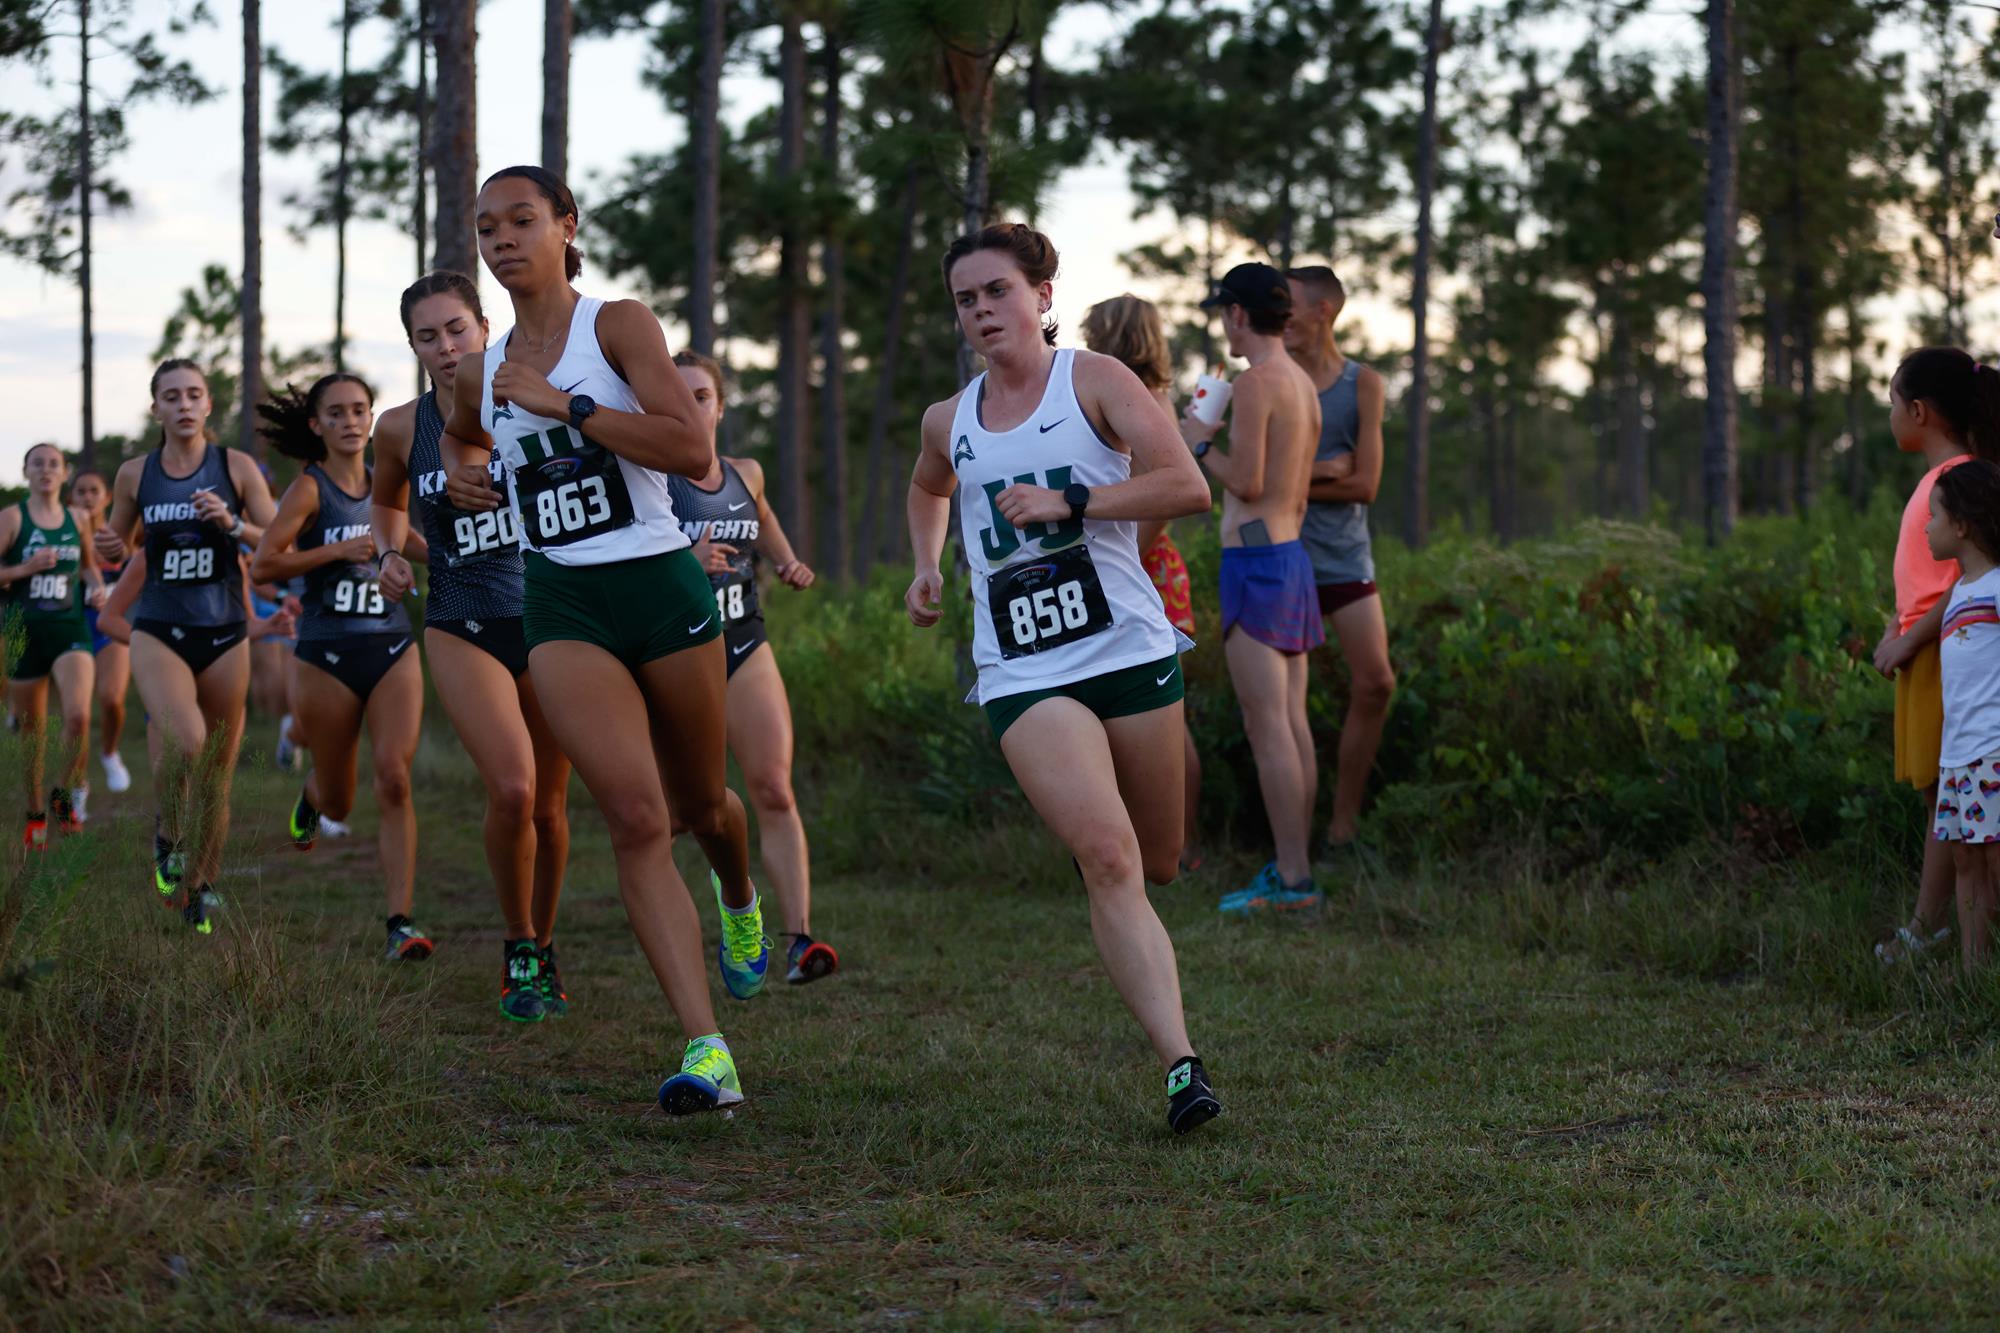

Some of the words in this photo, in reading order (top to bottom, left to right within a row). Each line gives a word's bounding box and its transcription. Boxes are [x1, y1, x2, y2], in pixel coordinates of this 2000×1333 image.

[144, 502, 228, 524] KNIG
[536, 475, 612, 540] 863
[454, 506, 520, 557] 920
[679, 520, 759, 540] NIGHTS
[163, 548, 214, 579] 928
[29, 575, 68, 599] 906
[334, 579, 384, 614] 913
[716, 584, 744, 622] 18
[1009, 579, 1089, 646] 858
